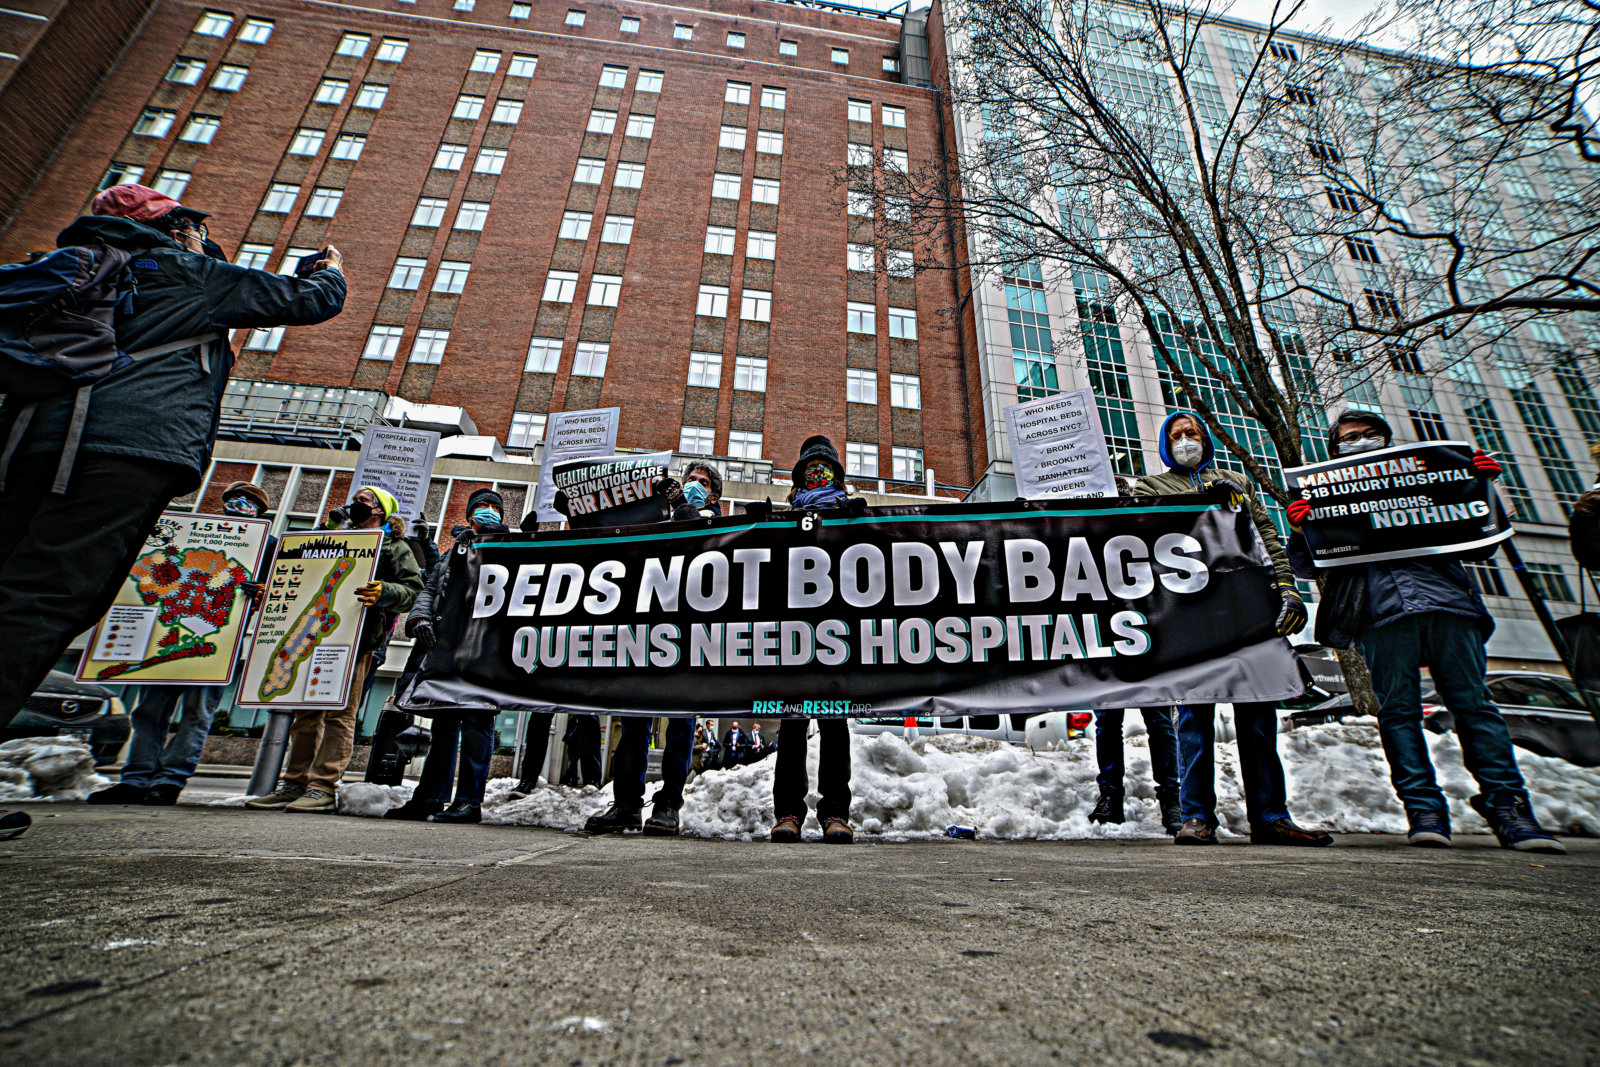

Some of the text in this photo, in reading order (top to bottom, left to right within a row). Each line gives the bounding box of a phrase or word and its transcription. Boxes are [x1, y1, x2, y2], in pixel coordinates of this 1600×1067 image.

[1025, 400, 1072, 416] WHO NEEDS
[580, 416, 601, 424] NEEDS
[1020, 410, 1082, 429] HOSPITAL BEDS
[376, 432, 426, 444] HOSPITAL BEDS
[556, 426, 606, 436] HOSPITAL BEDS
[1026, 422, 1082, 440] ACROSS NYC?
[1046, 443, 1076, 454] BRONX
[378, 454, 414, 463] RESIDENTS
[1040, 454, 1086, 468] BROOKLYN
[364, 468, 396, 476] MANHATTAN
[556, 466, 588, 489] HEALTH
[589, 462, 615, 476] CARE
[614, 460, 636, 473] FOR
[635, 458, 653, 468] ALL
[632, 466, 664, 480] CARE
[1038, 466, 1090, 482] MANHATTAN
[1296, 456, 1428, 489] MANHATTAN:
[1051, 481, 1086, 492] QUEENS
[1300, 468, 1474, 501] $1B LUXURY HOSPITAL
[567, 494, 598, 518] FOR
[599, 489, 614, 510] A
[1350, 496, 1434, 514] BOROUGHS:
[1370, 500, 1490, 530] NOTHING
[160, 518, 214, 531] EENS 1.5
[190, 531, 220, 539] Hospital
[301, 548, 377, 559] MANHATTAN
[472, 532, 1210, 619] BEDS NOT BODY BAGS
[265, 604, 280, 614] 6.4
[258, 630, 270, 638] per
[511, 610, 1152, 674] QUEENS NEEDS HOSPITALS
